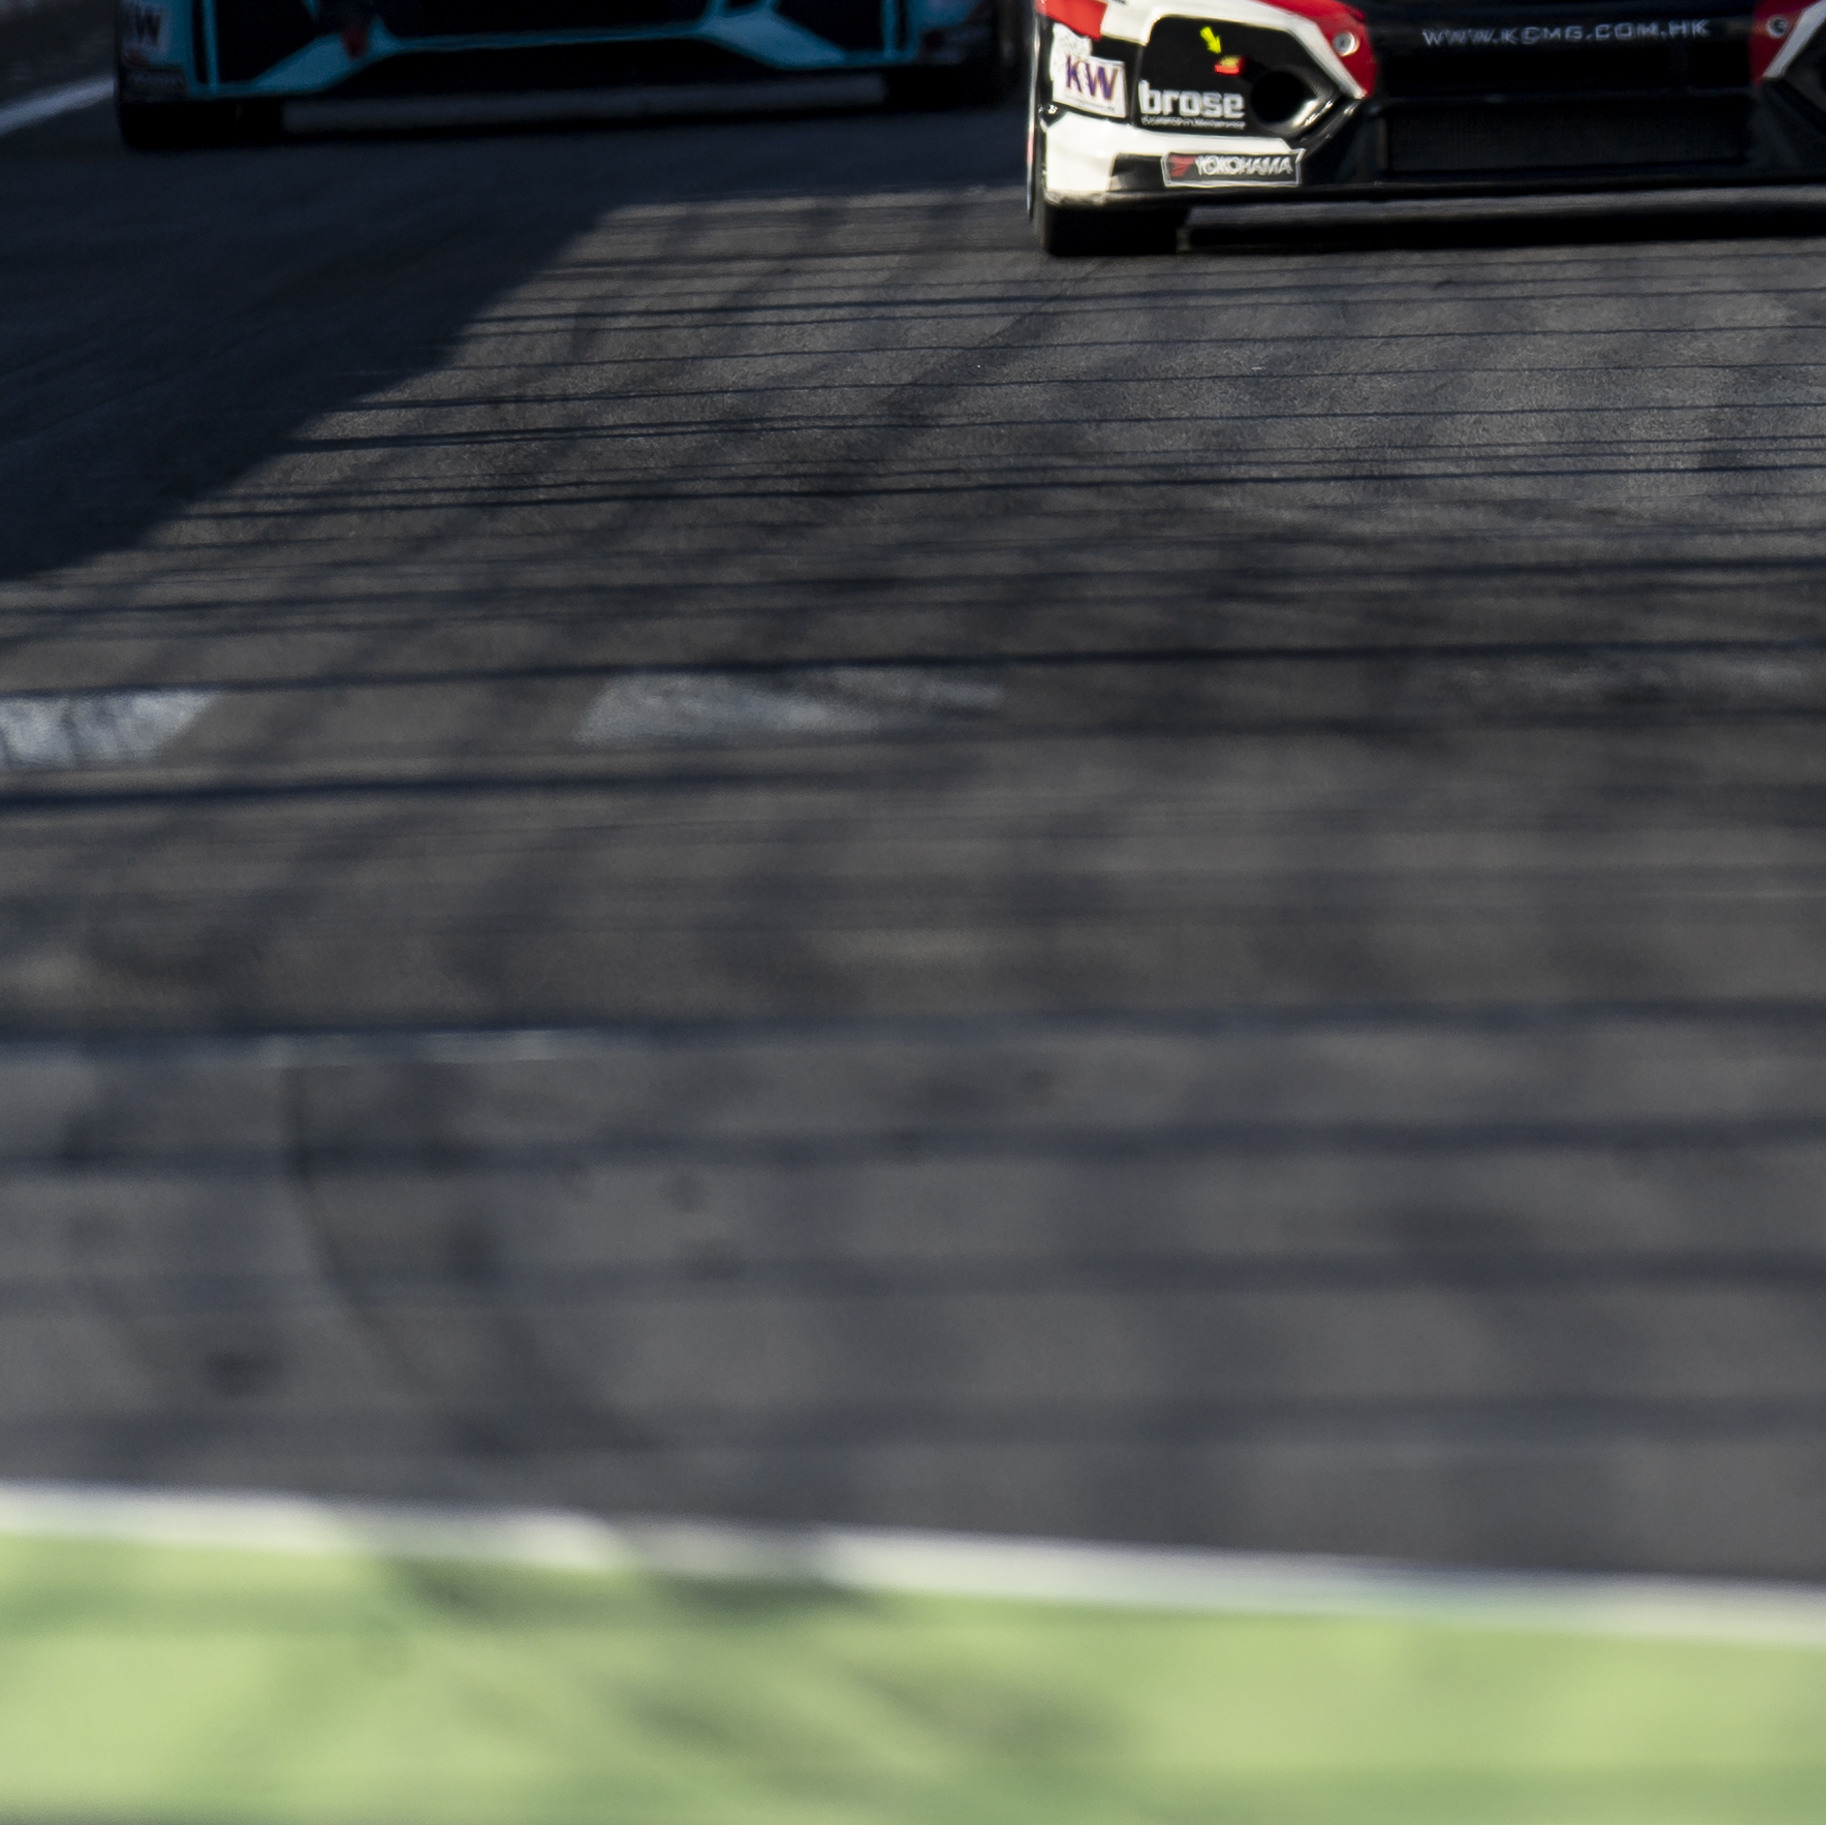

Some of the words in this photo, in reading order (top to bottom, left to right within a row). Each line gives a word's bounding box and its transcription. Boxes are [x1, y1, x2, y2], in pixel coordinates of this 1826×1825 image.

[1065, 54, 1120, 101] KW
[1138, 80, 1245, 118] brose
[1195, 155, 1294, 176] YOKOHAMA
